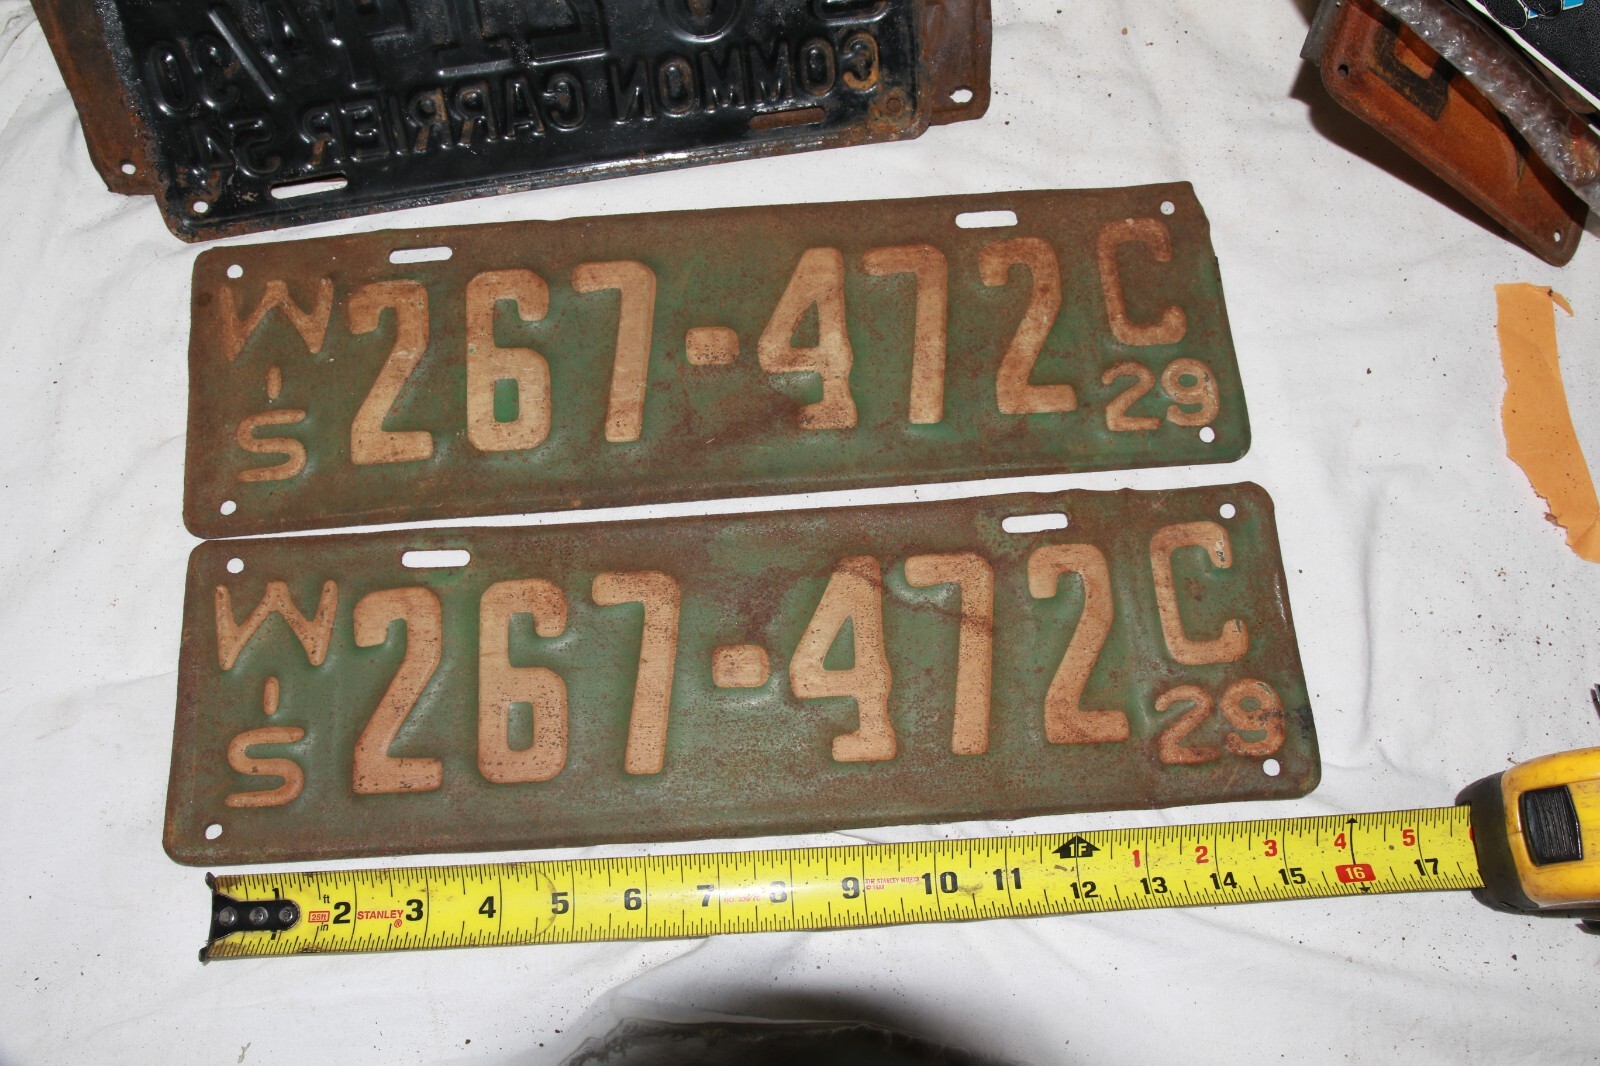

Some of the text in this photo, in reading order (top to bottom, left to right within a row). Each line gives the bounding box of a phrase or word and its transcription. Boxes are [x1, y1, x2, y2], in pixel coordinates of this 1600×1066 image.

[1097, 217, 1188, 346] C
[348, 236, 1077, 465] 267-472
[1101, 357, 1221, 431] 29
[1150, 521, 1250, 665] C
[352, 543, 1130, 794] 267-472
[1155, 678, 1286, 765] 29
[1264, 839, 1278, 857] 3
[1334, 832, 1347, 850] 4
[1402, 829, 1415, 847] 5
[1133, 850, 1141, 868] 1
[1195, 845, 1209, 864] 2
[993, 867, 1023, 890] 11
[1278, 867, 1307, 886] 15
[1345, 865, 1366, 880] 16
[1413, 858, 1440, 876] 17
[841, 876, 861, 899] 9
[921, 871, 958, 894] 10
[1069, 880, 1099, 899] 12
[1140, 876, 1168, 895] 13
[1210, 871, 1238, 889] 14
[323, 894, 331, 904] ft
[551, 891, 569, 914] 5
[623, 888, 642, 911] 6
[696, 884, 715, 907] 7
[769, 880, 788, 904] 8
[311, 913, 327, 921] 25ft
[333, 901, 351, 924] 2
[356, 909, 404, 920] STANLEY
[405, 898, 424, 922] 3
[478, 895, 497, 918] 4
[320, 922, 329, 931] in
